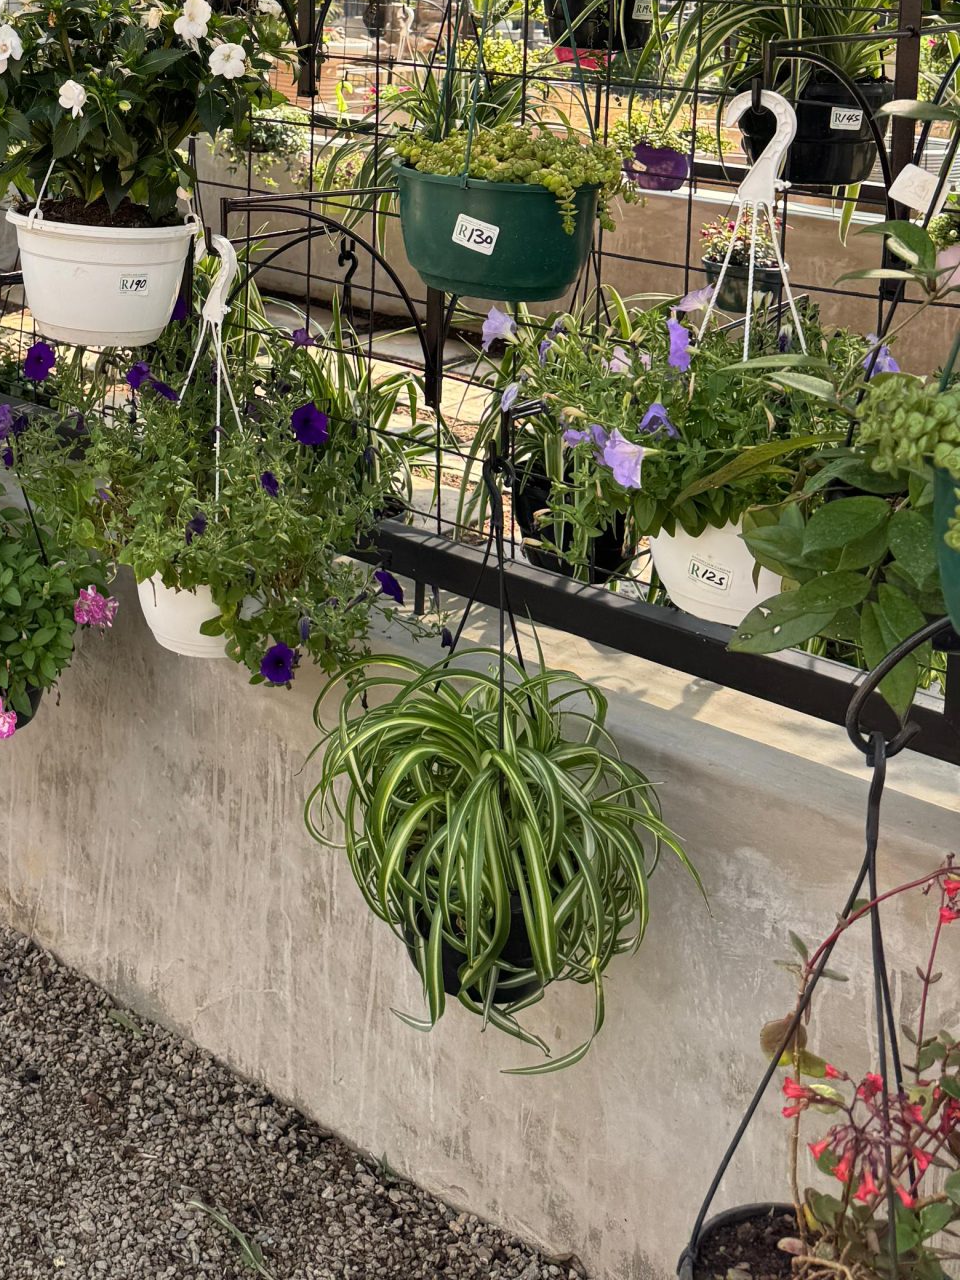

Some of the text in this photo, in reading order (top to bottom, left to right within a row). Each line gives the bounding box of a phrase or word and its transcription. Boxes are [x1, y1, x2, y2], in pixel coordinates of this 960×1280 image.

[834, 112, 860, 123] R145
[458, 224, 493, 244] R130
[121, 279, 147, 291] R190
[691, 562, 726, 586] R125
